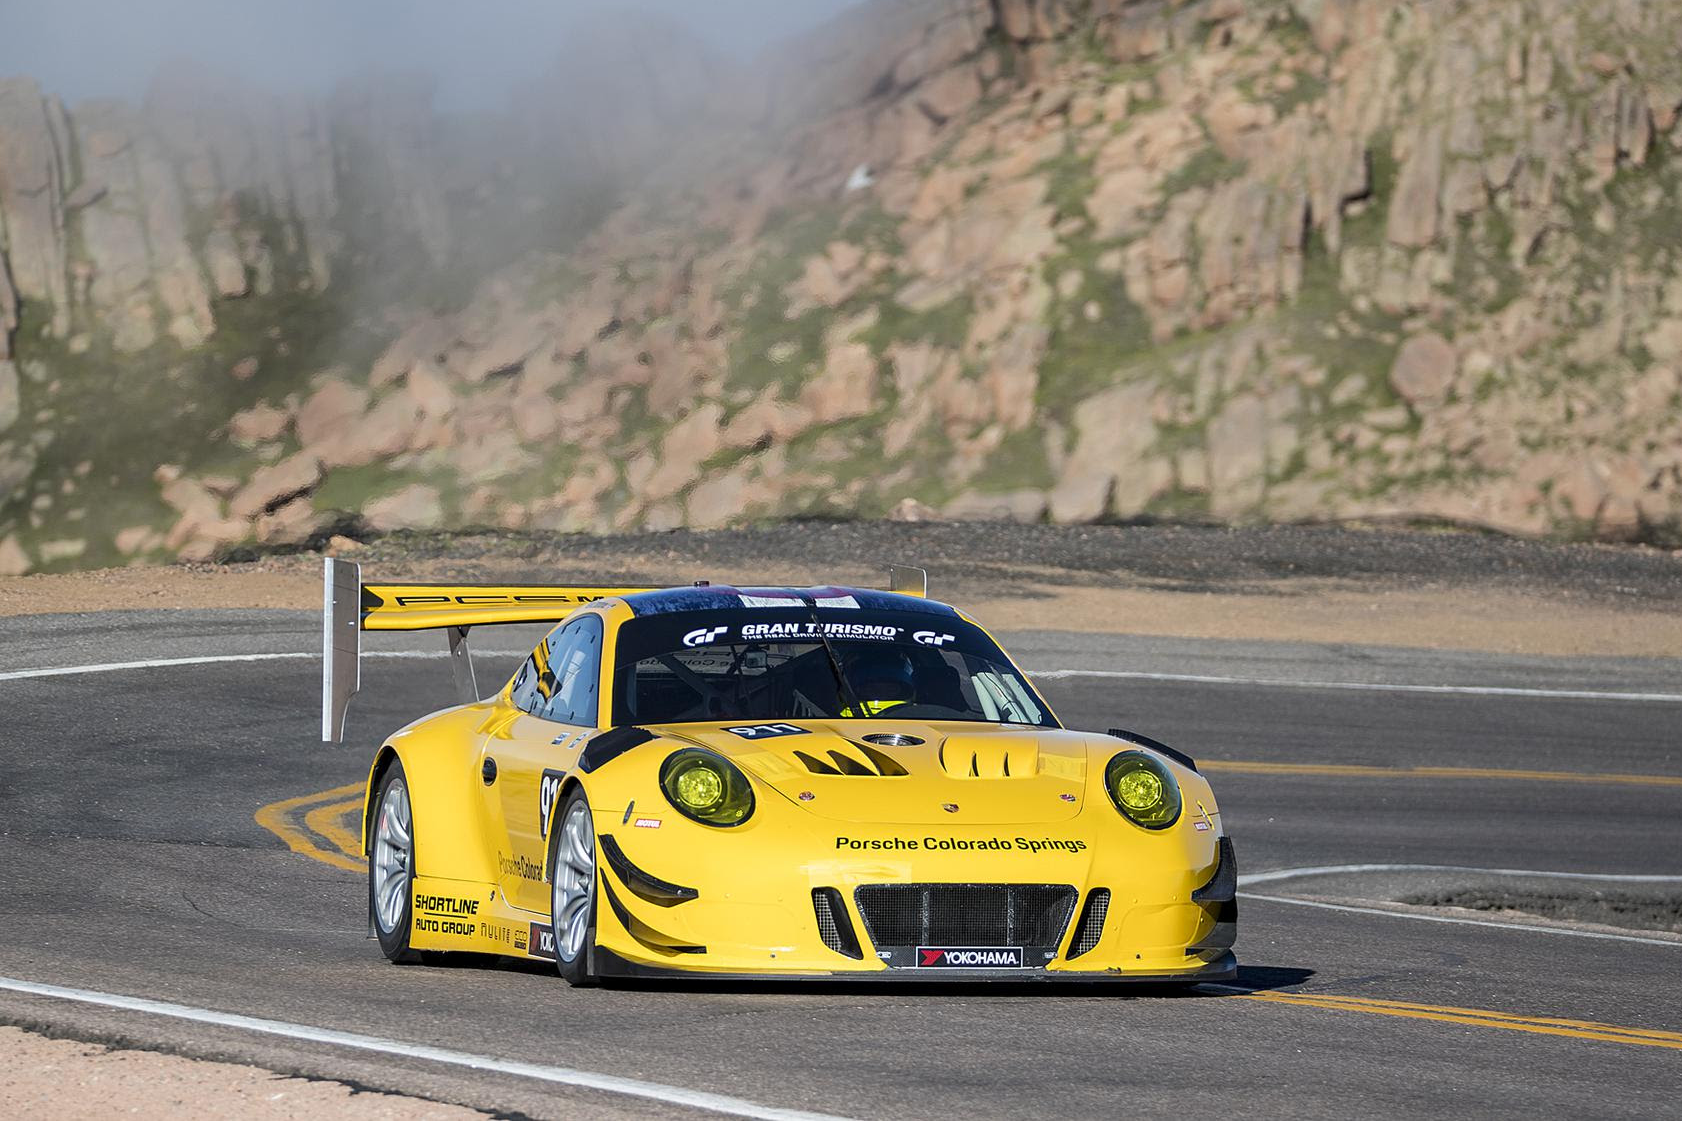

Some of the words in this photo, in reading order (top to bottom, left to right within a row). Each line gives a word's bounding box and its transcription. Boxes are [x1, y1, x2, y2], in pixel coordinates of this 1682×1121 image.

[741, 623, 799, 635] GRAN
[836, 633, 895, 641] SIMULATOR
[728, 724, 802, 736] 911
[836, 837, 918, 849] Porsche
[923, 837, 1012, 850] Colorado
[1014, 837, 1087, 853] Springs
[415, 894, 479, 915] SHORTLINE
[416, 918, 439, 932] AUTO
[441, 921, 476, 936] GROUP
[943, 952, 1018, 965] YOKOHAMA
